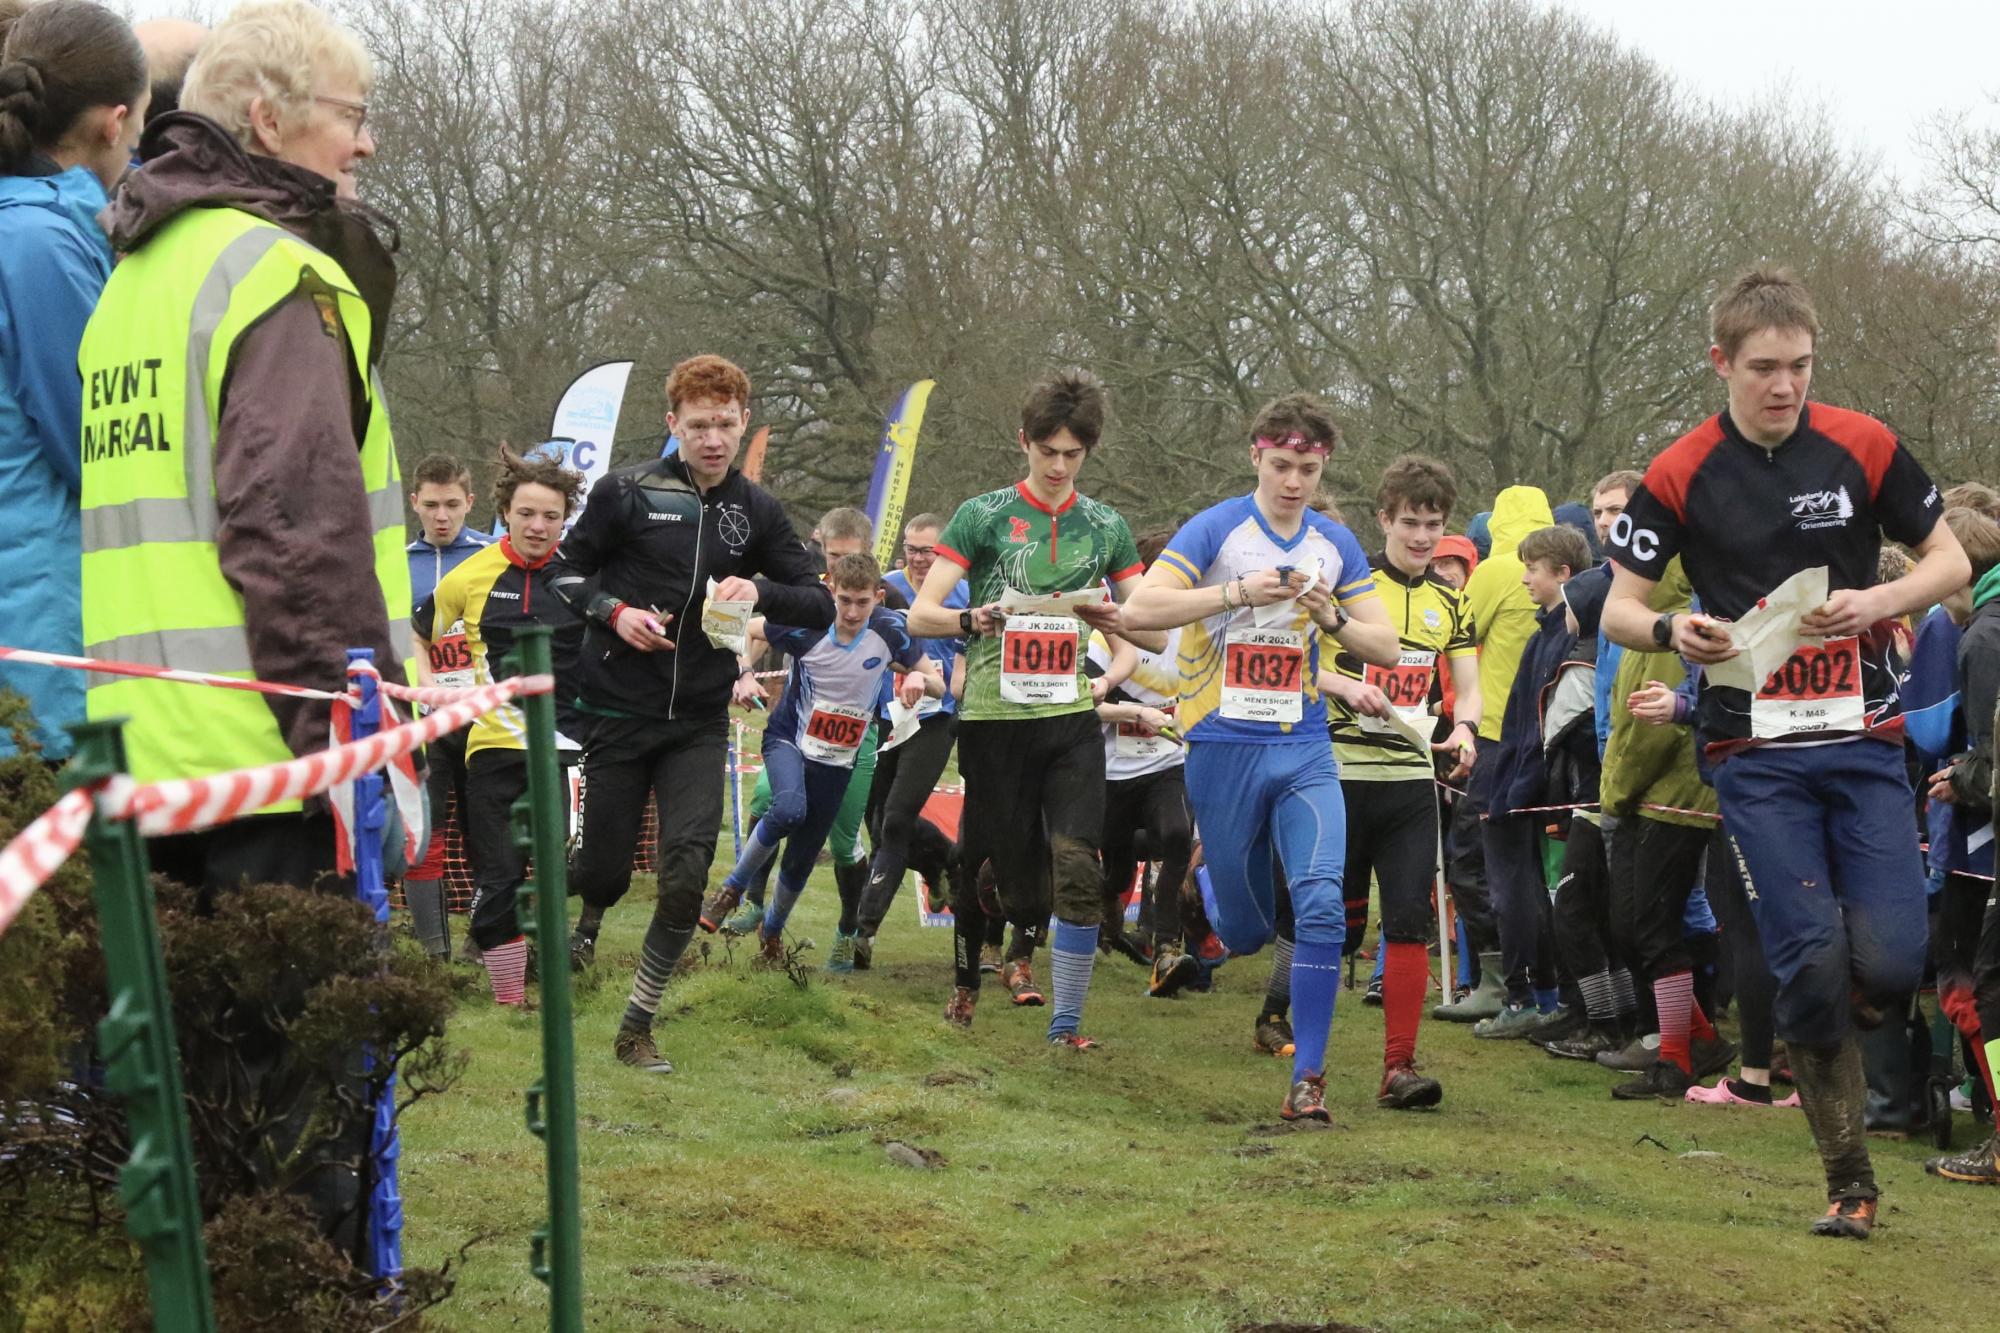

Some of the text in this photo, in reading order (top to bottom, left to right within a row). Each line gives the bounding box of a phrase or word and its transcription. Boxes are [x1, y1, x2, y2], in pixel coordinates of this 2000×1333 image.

[1789, 490, 1824, 503] Lakeland
[647, 511, 683, 522] TRIMTEX
[875, 460, 905, 563] HERTFORDSHIR
[1800, 518, 1848, 531] Orienteering
[881, 503, 904, 573] ORIENTEE
[489, 590, 521, 600] TRIMTEX
[1028, 622, 1066, 631] JK 2024
[1251, 634, 1290, 645] JK 2024
[428, 638, 473, 671] 005
[1012, 638, 1074, 672] 1010
[1401, 656, 1422, 664] 2024
[1235, 651, 1301, 688] 1037
[1374, 671, 1427, 704] 1042
[1268, 697, 1294, 705] SHORT
[1789, 709, 1797, 717] K
[814, 716, 861, 744] 1005
[1729, 834, 1760, 901] TRIMTEX
